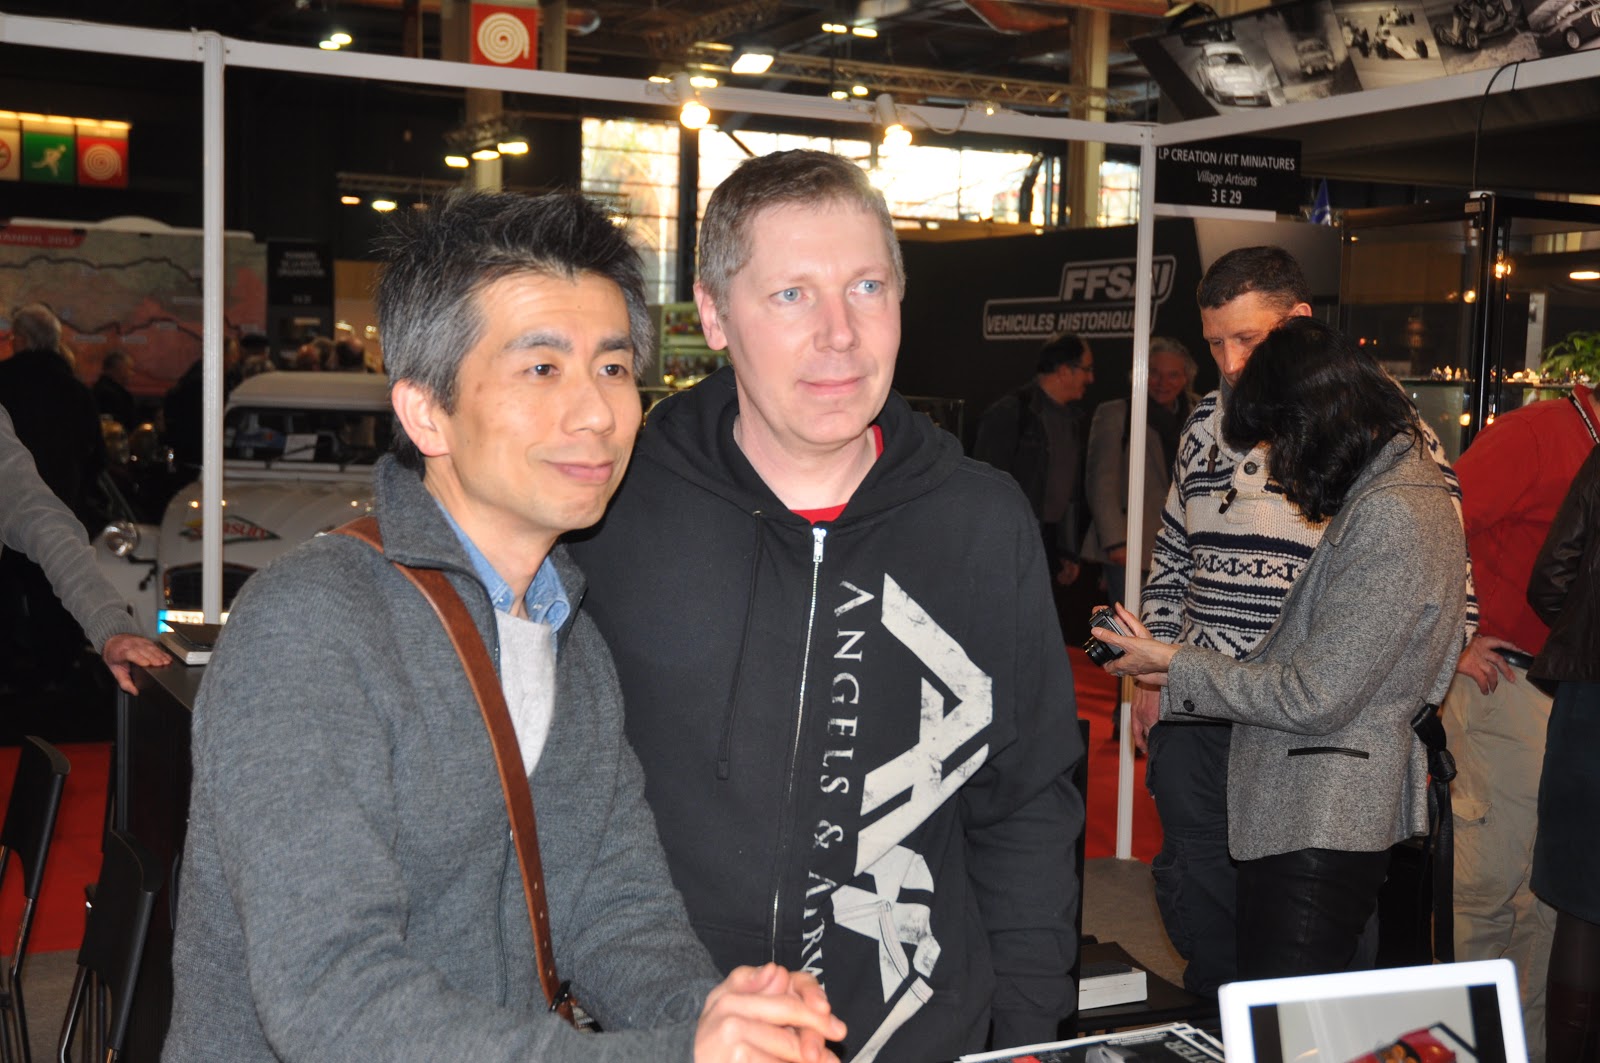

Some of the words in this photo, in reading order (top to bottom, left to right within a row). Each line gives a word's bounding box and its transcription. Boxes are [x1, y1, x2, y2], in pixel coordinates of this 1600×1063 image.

[1158, 147, 1170, 161] LP
[1171, 148, 1217, 165] CREATION
[1224, 152, 1239, 166] KIT
[1240, 154, 1295, 171] MINIATURES
[1197, 169, 1224, 187] Village
[1225, 172, 1258, 187] Artisans
[1211, 188, 1218, 203] 3
[1220, 189, 1227, 203] E
[1229, 190, 1242, 205] 29
[987, 313, 1055, 333] VEHICULES
[812, 819, 844, 849] &
